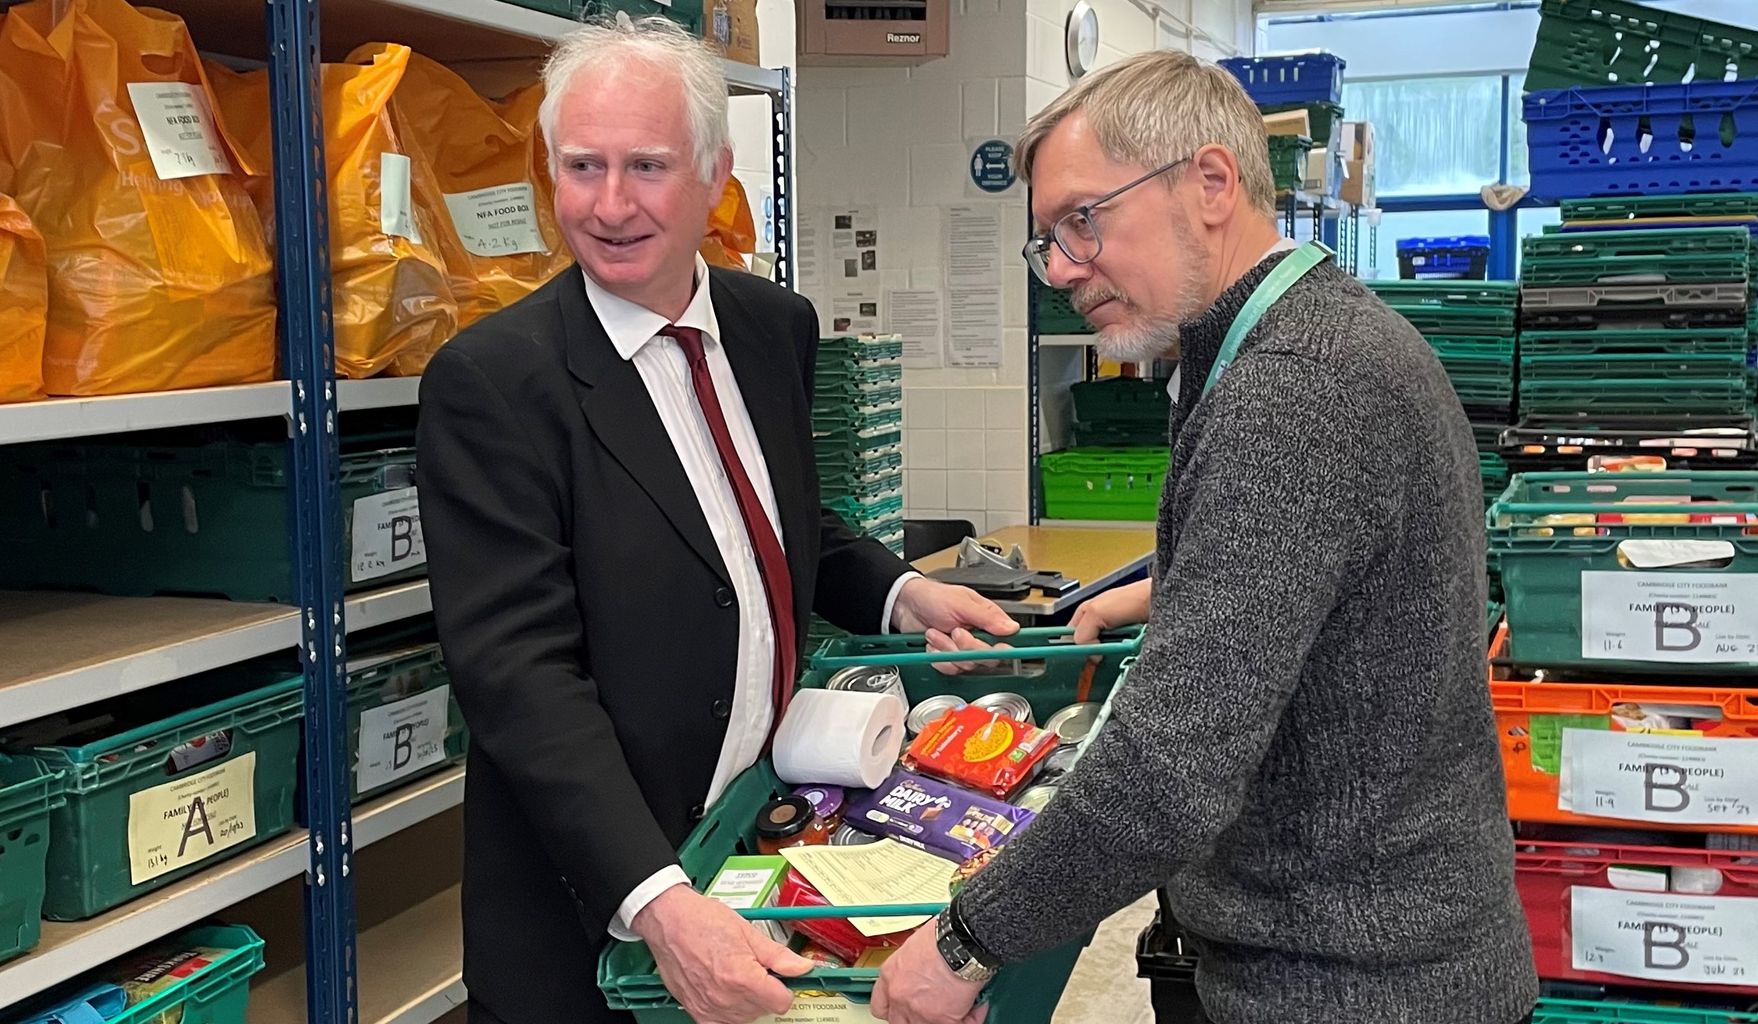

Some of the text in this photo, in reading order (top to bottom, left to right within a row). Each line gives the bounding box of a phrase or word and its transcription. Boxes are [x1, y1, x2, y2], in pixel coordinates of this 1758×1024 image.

[886, 33, 920, 43] Reznor
[178, 114, 191, 125] FOOD
[476, 210, 493, 219] NFA
[494, 205, 516, 215] FOOD
[391, 515, 412, 562] B
[1629, 602, 1668, 614] FAMILY
[1692, 604, 1736, 615] PEOPLE)
[1655, 601, 1702, 651] B
[393, 723, 413, 771] B
[1618, 762, 1656, 773] FAMILY
[1682, 767, 1724, 778] PEOPLE)
[889, 785, 932, 807] DAIRY
[1645, 762, 1690, 813] B
[163, 803, 192, 820] FAMILY
[206, 787, 230, 806] PEOPLE)
[879, 794, 917, 814] MILK
[177, 796, 214, 858] A
[1681, 925, 1723, 937] PEOPLE)
[1644, 920, 1690, 970] B
